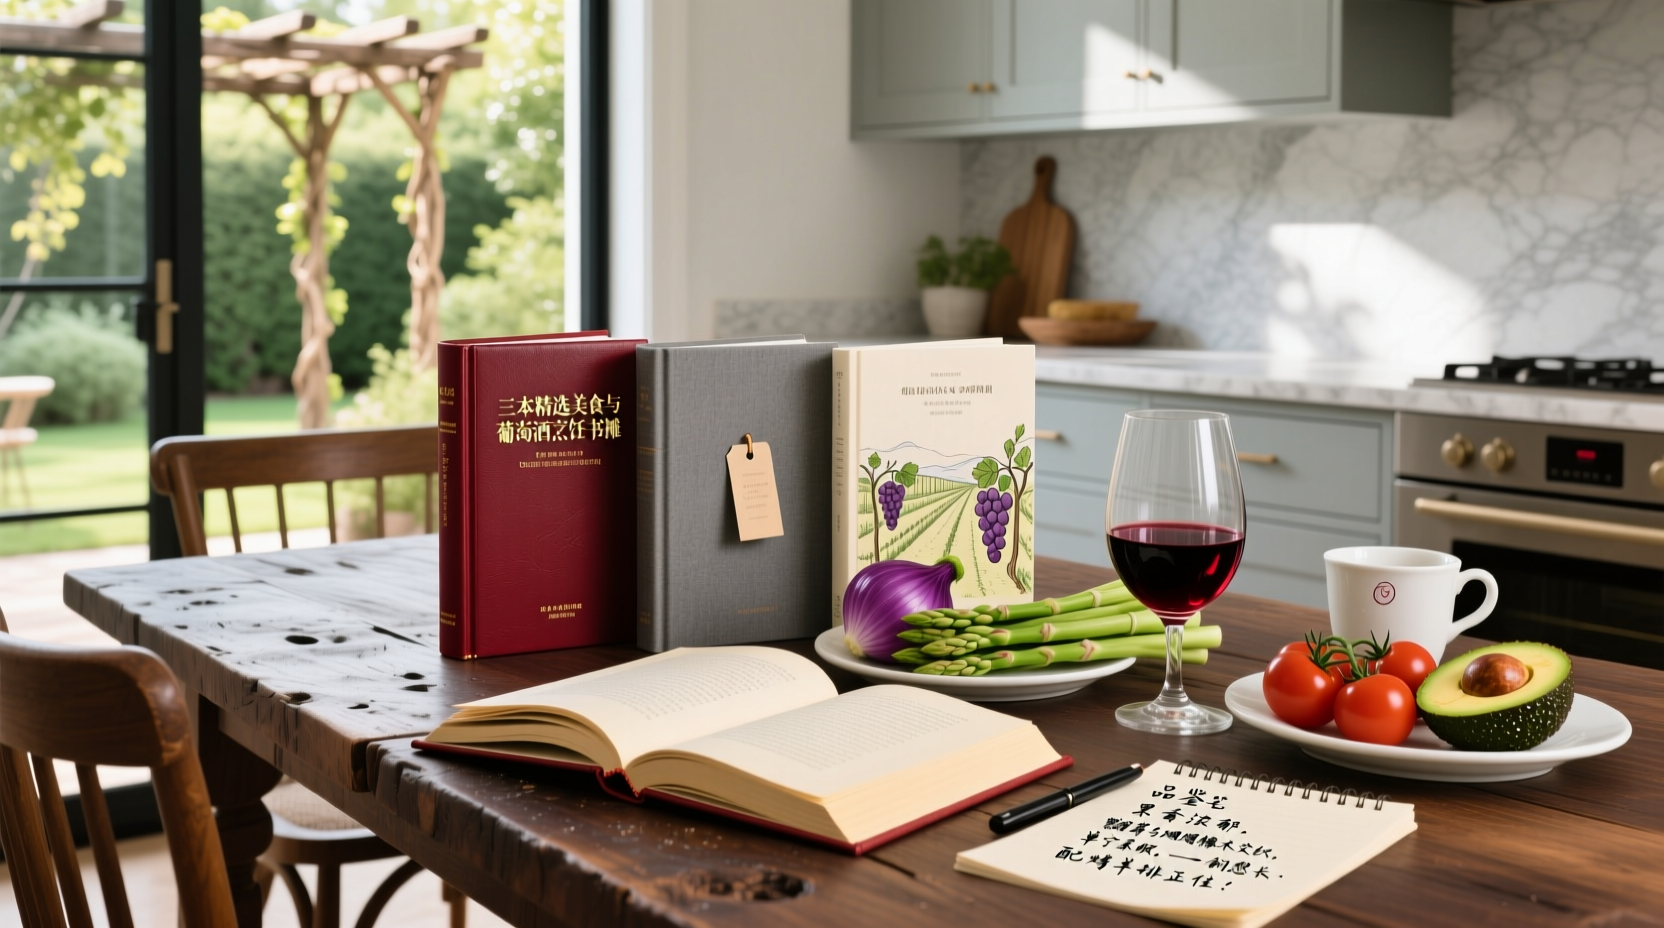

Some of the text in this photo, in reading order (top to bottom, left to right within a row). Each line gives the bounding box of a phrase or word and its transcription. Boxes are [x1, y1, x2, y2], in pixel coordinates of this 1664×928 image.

[497, 393, 621, 418] 三本精选美食与
